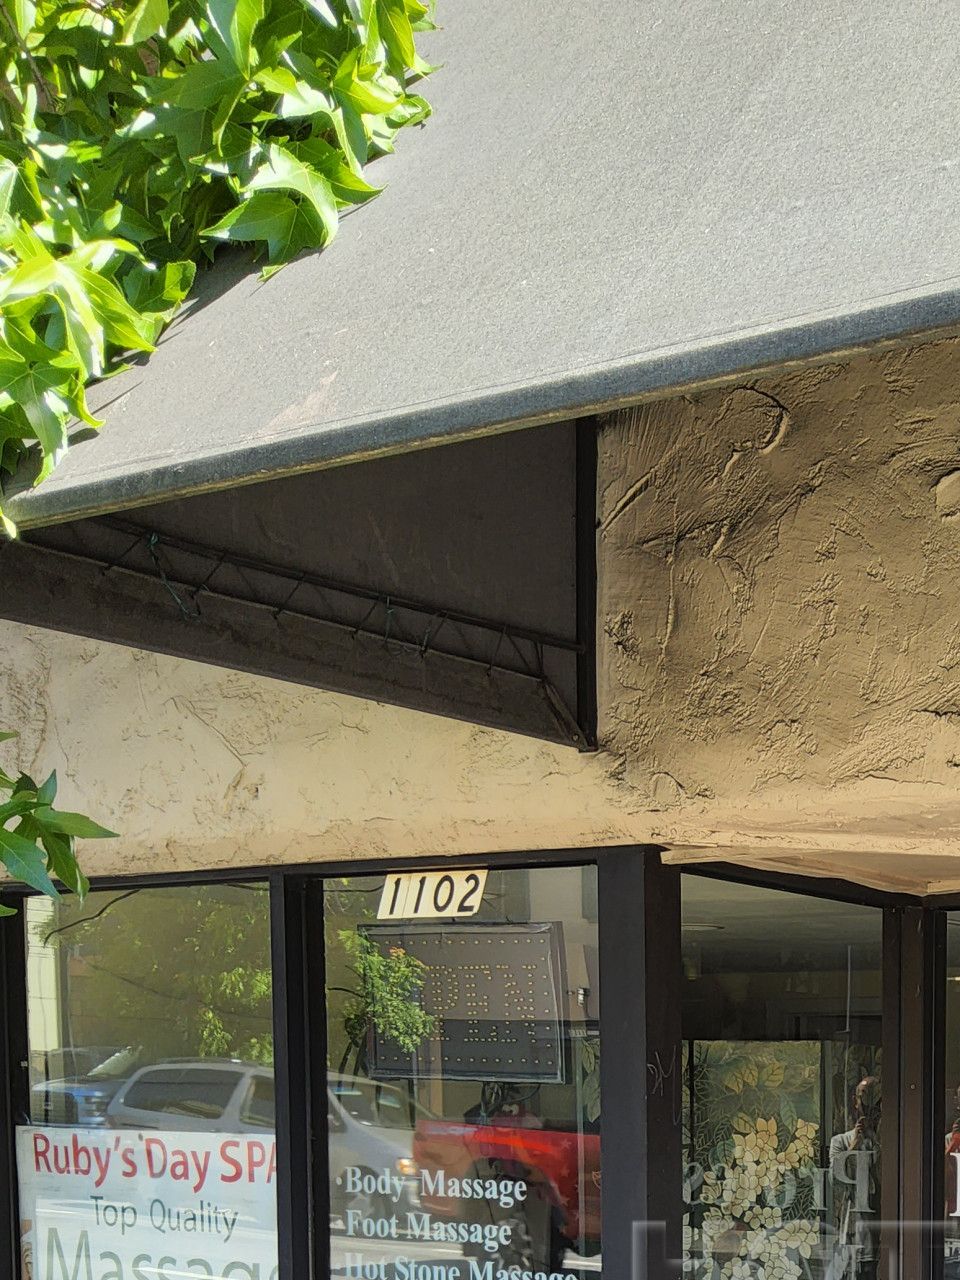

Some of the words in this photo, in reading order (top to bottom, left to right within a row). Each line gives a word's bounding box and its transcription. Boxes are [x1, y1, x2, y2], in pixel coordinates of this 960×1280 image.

[388, 873, 480, 916] 1102
[412, 964, 538, 1044] PEN
[33, 1133, 138, 1188] Ruby's
[143, 1138, 211, 1194] Day
[345, 1166, 406, 1203] Body
[420, 1168, 528, 1208] Massage
[90, 1195, 137, 1235] Top
[149, 1198, 239, 1243] Quality
[346, 1209, 400, 1239] Foot
[406, 1212, 512, 1252] Massage
